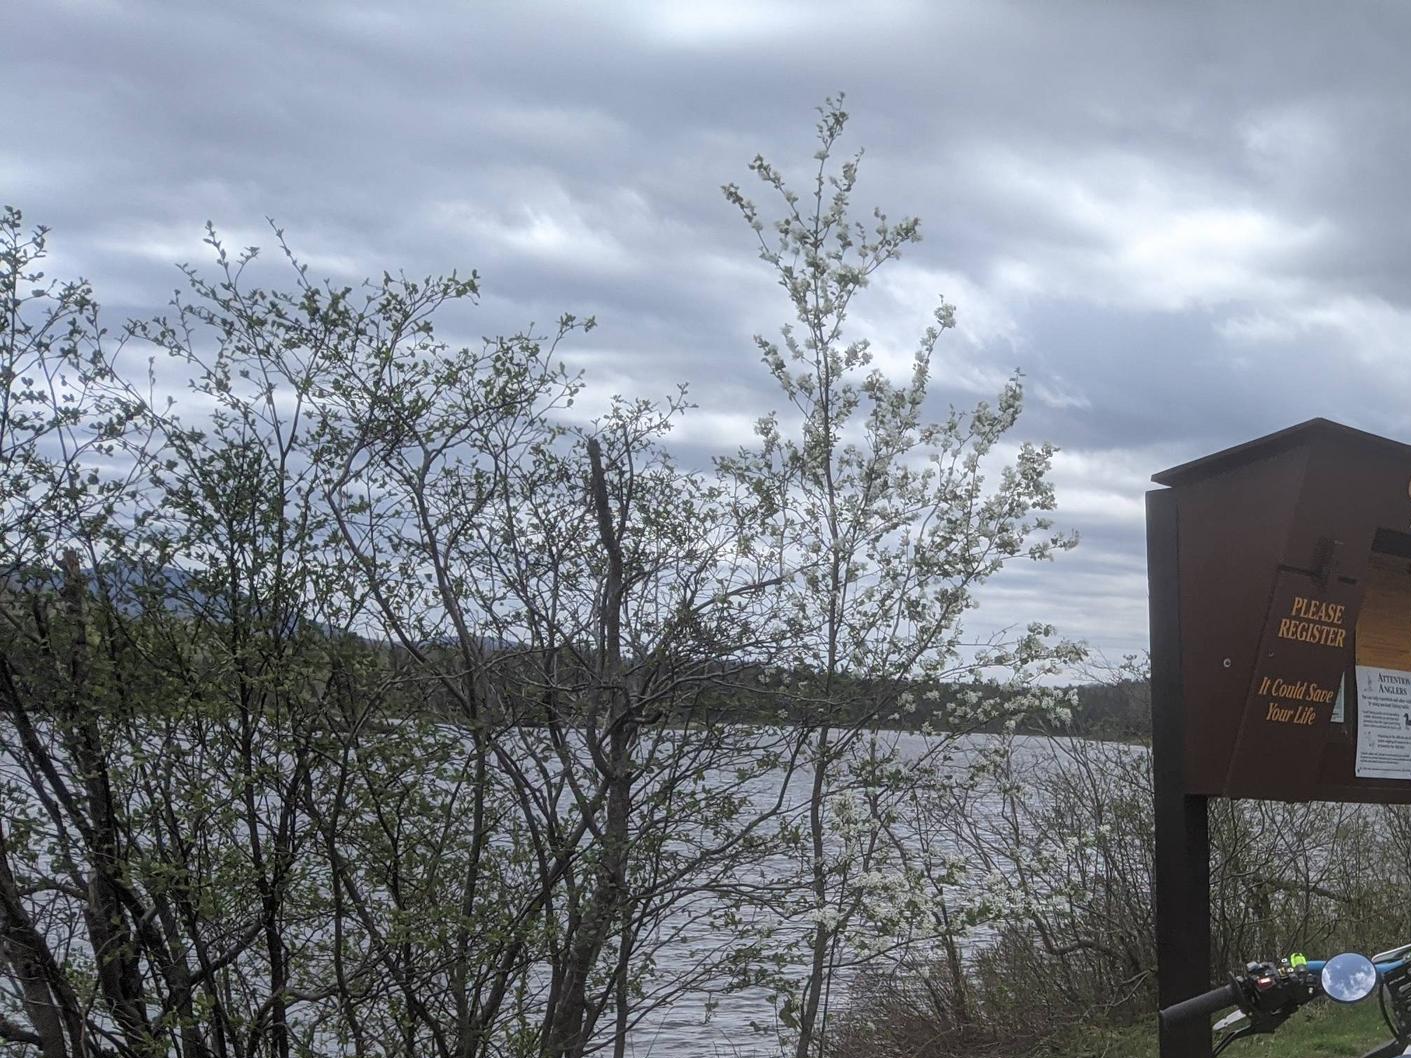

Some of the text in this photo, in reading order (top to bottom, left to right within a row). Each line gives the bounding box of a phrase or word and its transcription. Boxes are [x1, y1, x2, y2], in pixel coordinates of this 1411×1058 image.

[1291, 596, 1344, 624] PLEASE
[1278, 618, 1346, 648] REGISTER
[1258, 676, 1334, 703] It Could Save
[1377, 672, 1410, 686] ATTENTION
[1378, 683, 1408, 696] ANGLERS
[1265, 702, 1293, 723] Your
[1294, 706, 1317, 726] Life
